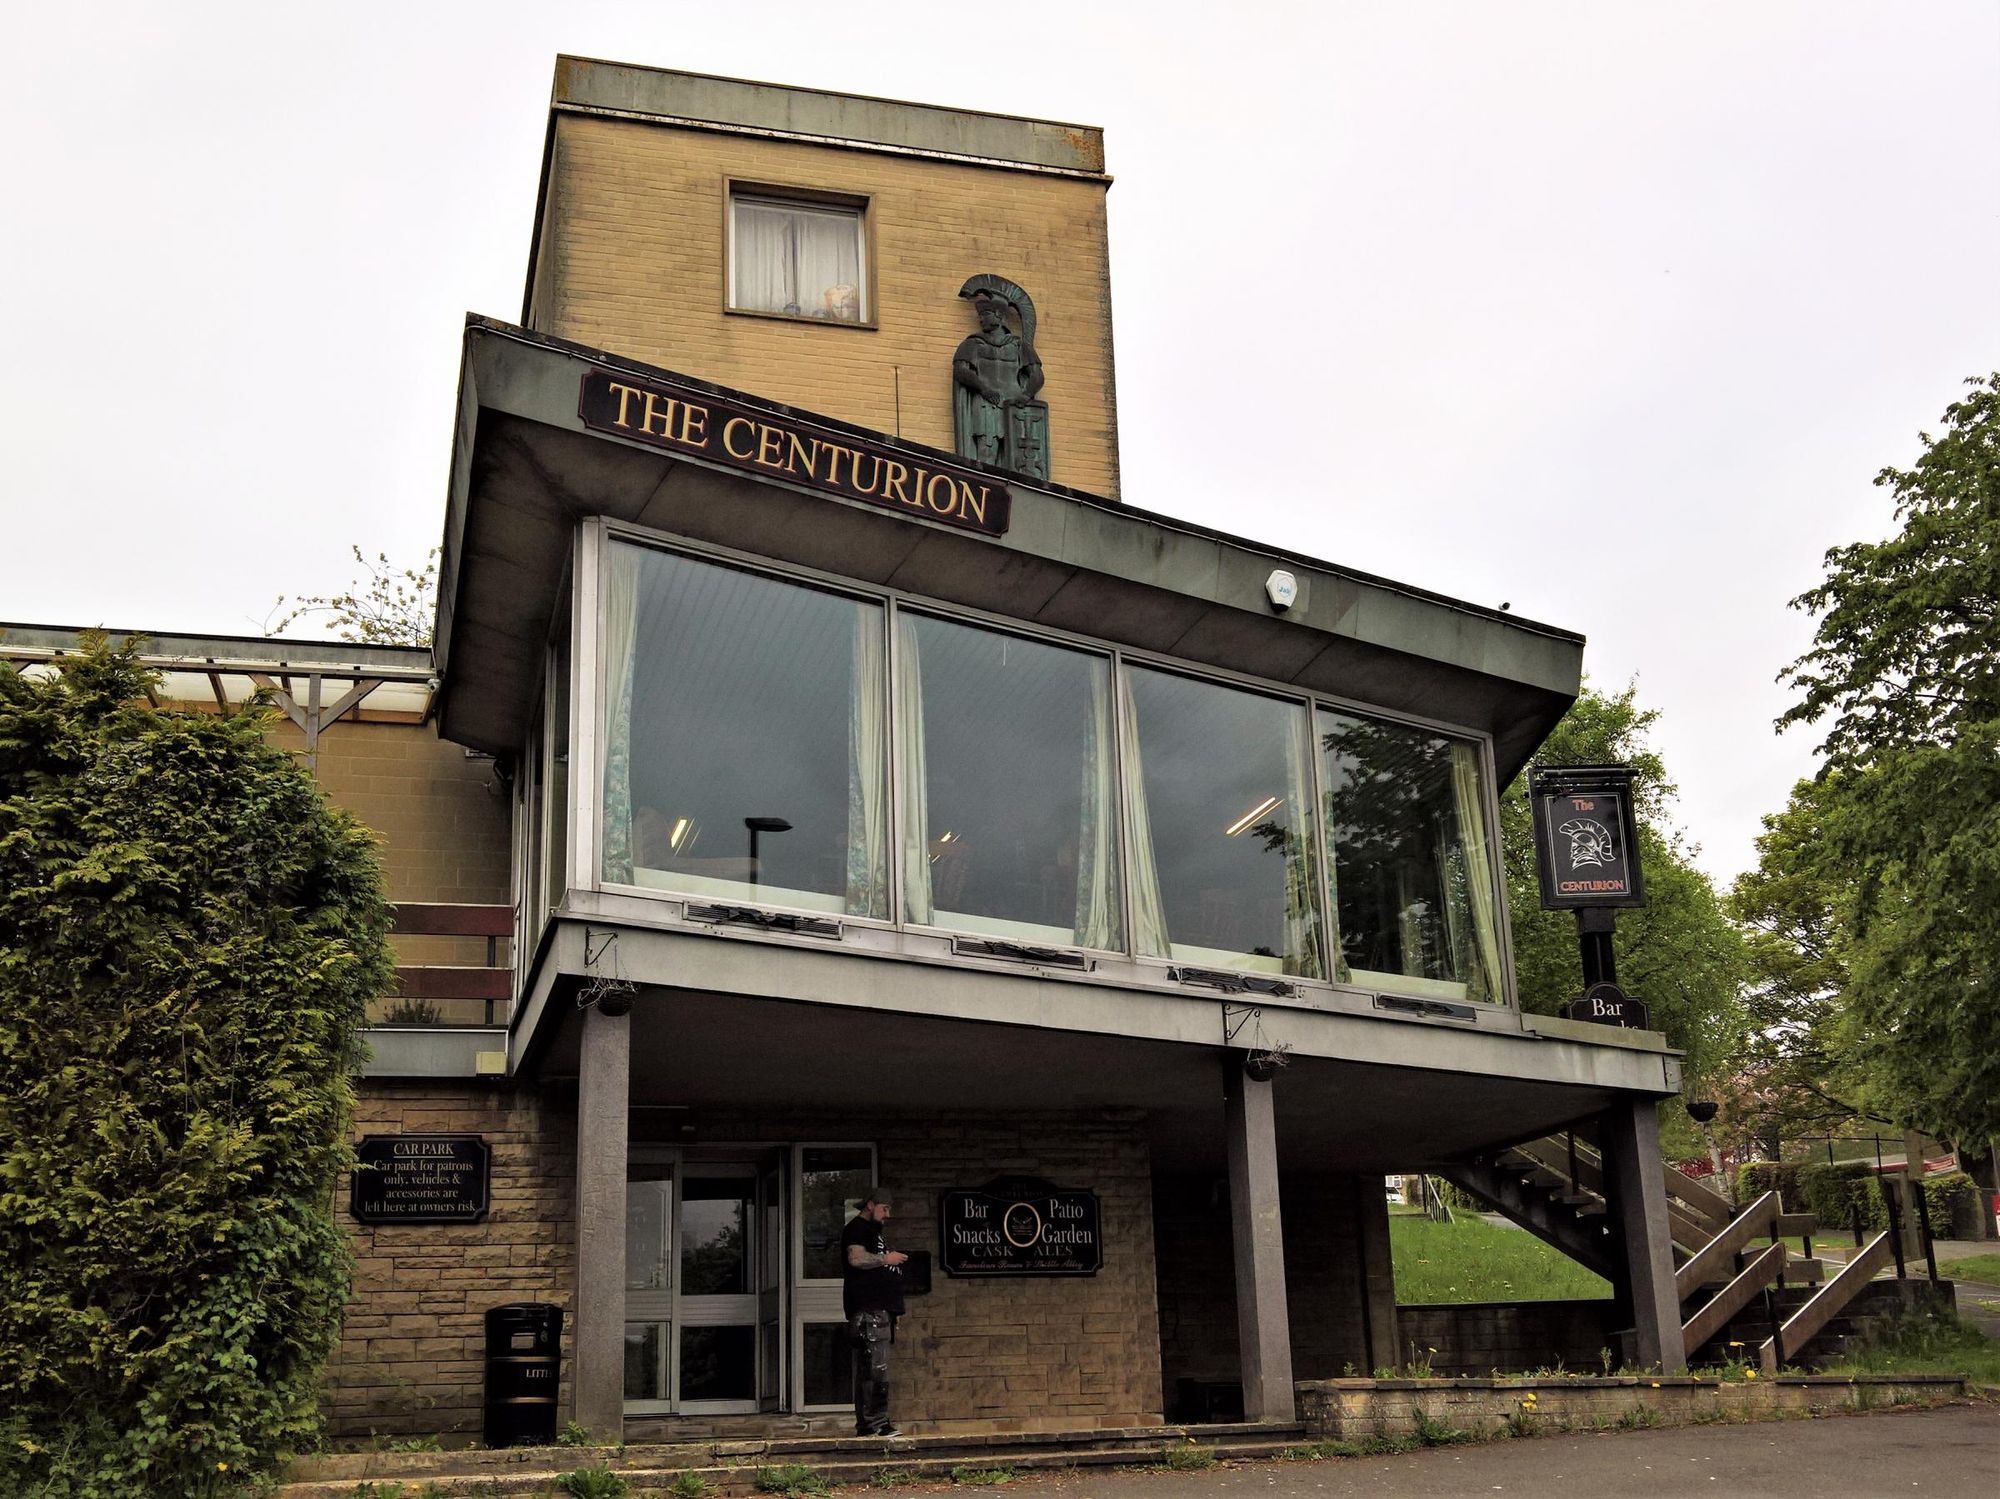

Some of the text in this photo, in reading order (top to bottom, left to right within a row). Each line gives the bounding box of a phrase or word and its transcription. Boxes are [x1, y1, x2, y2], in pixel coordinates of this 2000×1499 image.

[609, 382, 990, 525] THE CENTURION
[1572, 799, 1595, 811] The
[1560, 880, 1623, 892] CENTURION
[1591, 998, 1623, 1016] Bar
[394, 1143, 454, 1155] CAR PARK
[373, 1160, 473, 1173] Car park for patrons
[411, 1173, 450, 1184] vehicles
[452, 1173, 461, 1184] &
[386, 1187, 458, 1198] accessories are
[365, 1200, 476, 1212] left here at owners risk
[964, 1199, 989, 1218] Bar
[1050, 1199, 1083, 1218] Patio
[953, 1223, 1000, 1244] Snacks
[1042, 1223, 1092, 1244] Garden
[972, 1246, 1073, 1257] CASK ALES
